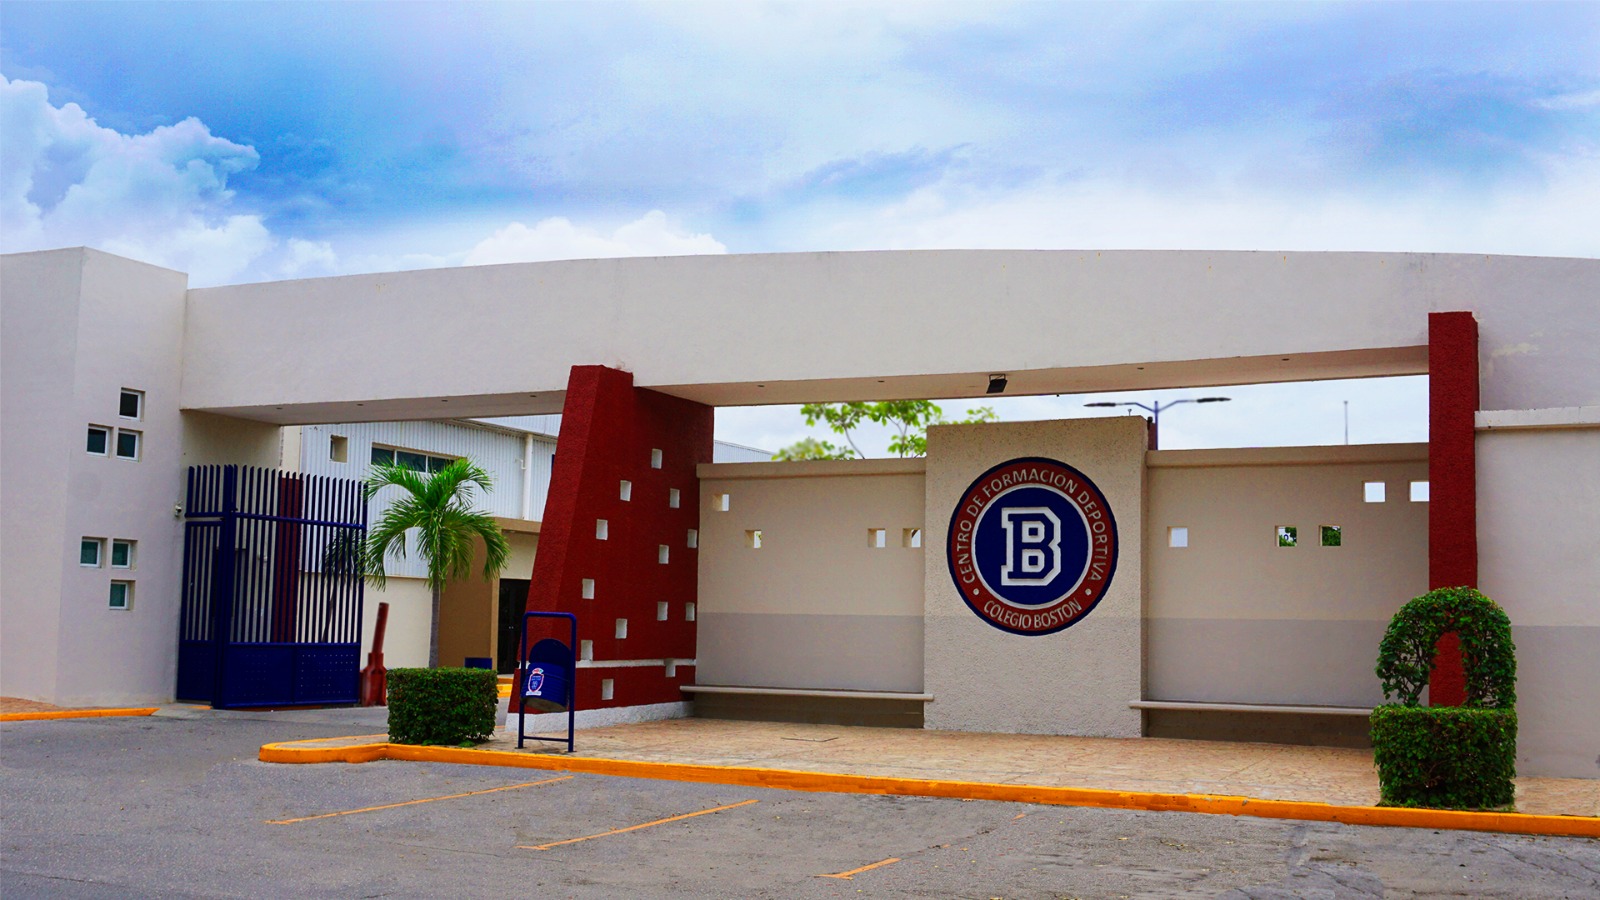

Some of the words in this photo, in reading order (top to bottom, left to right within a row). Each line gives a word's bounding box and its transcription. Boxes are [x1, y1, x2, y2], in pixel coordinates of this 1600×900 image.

[957, 520, 975, 584] CENTRO
[967, 495, 985, 517] DE
[1076, 490, 1108, 582] DEPORTIVA
[1001, 506, 1061, 586] B
[983, 600, 1032, 629] COLEGIO
[1034, 597, 1082, 629] BOSTON
